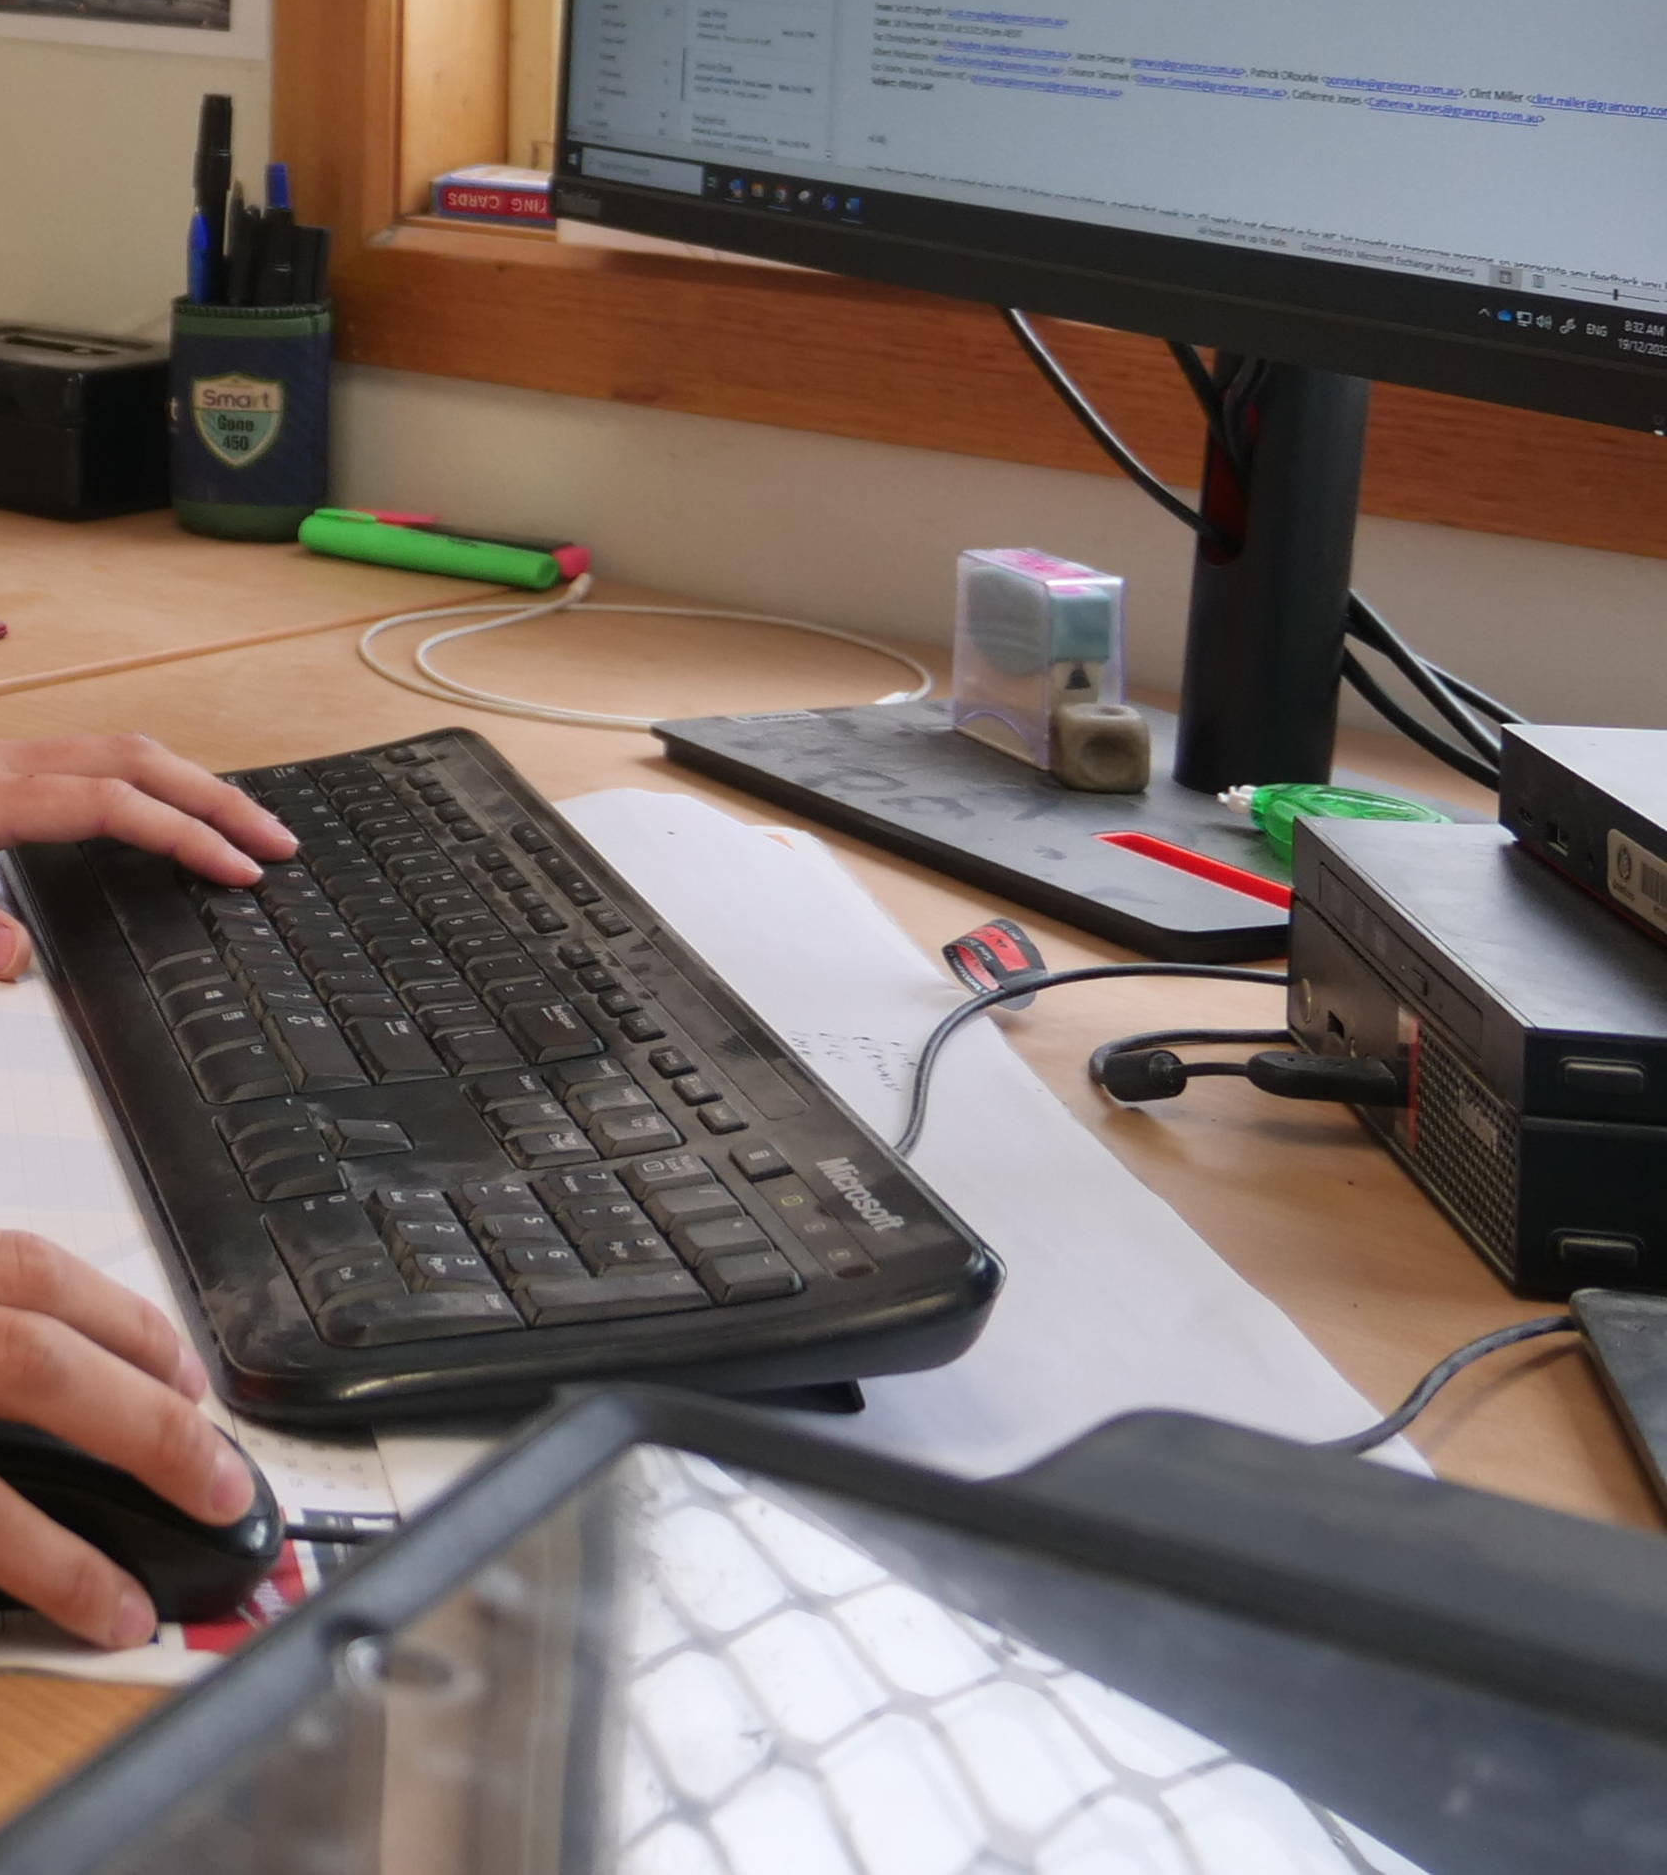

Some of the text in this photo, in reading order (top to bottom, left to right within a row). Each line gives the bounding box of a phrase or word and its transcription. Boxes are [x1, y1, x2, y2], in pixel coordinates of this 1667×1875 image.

[447, 191, 501, 210] CARDS
[1646, 322, 1666, 338] AM
[202, 387, 270, 410] Smart
[816, 1156, 905, 1232] Microsoft
